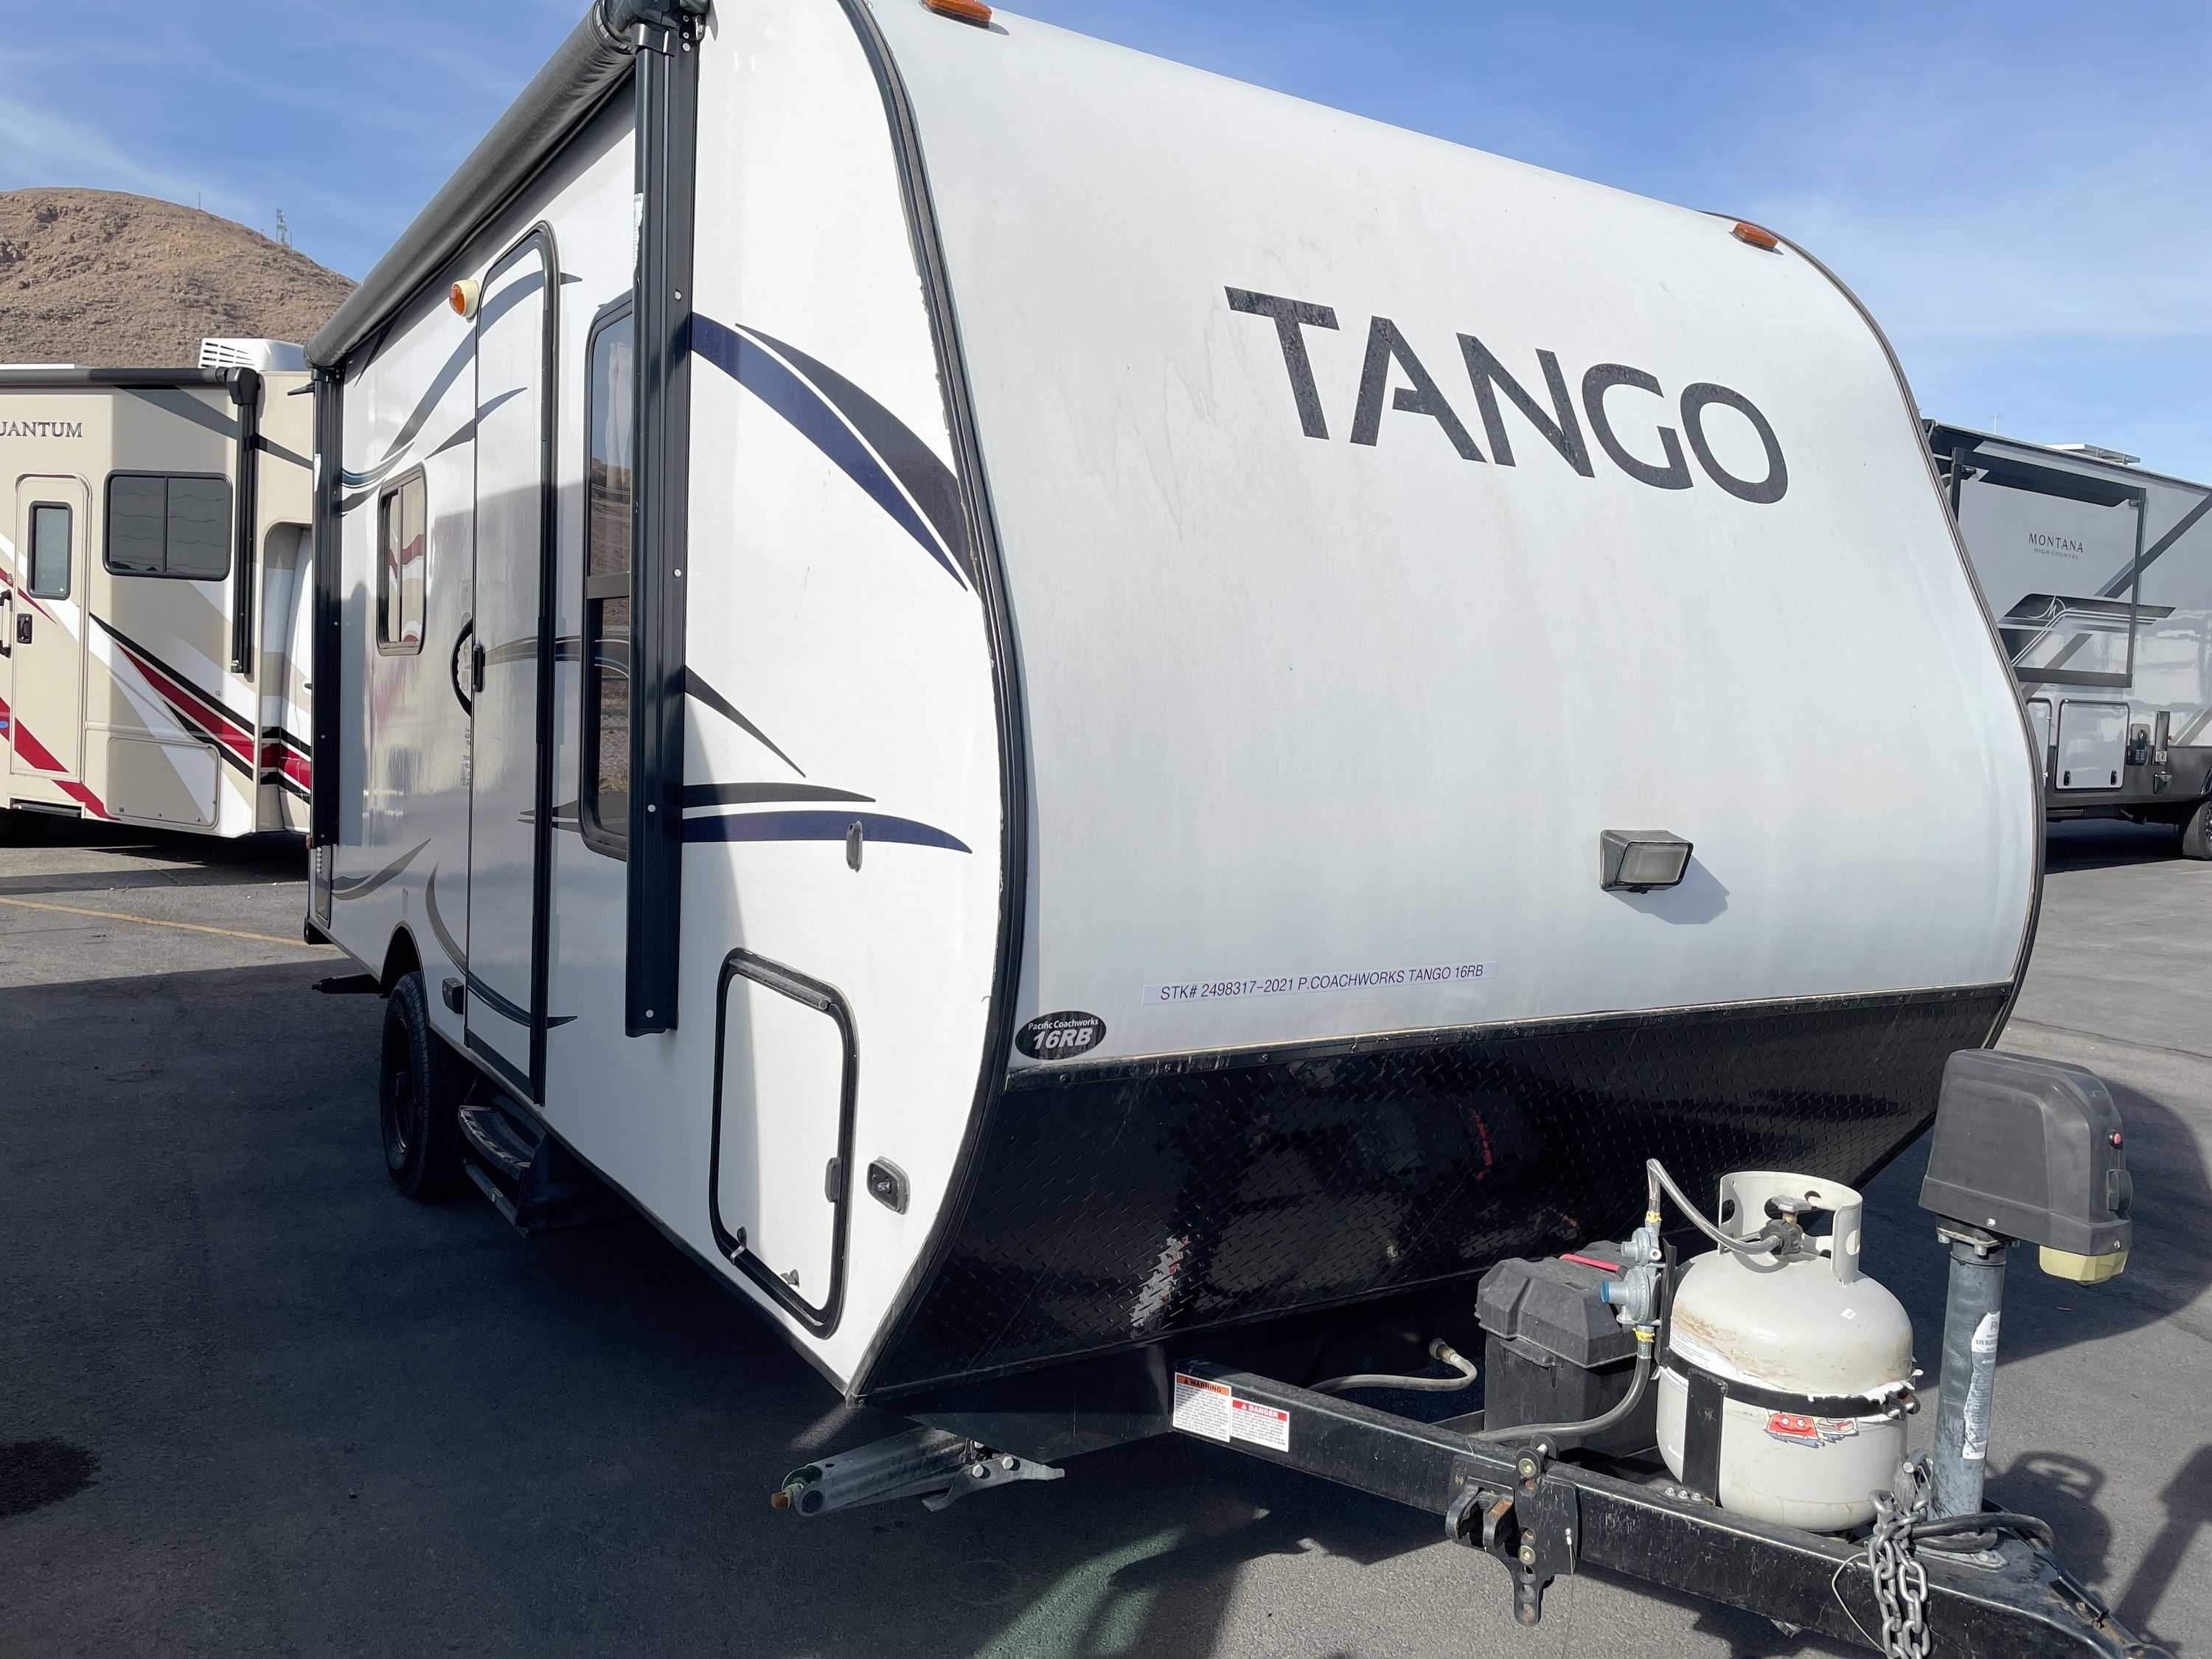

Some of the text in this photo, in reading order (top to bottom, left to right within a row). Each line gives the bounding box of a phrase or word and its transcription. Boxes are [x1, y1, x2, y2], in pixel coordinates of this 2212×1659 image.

[1224, 285, 1788, 504] TANGO
[2028, 532, 2083, 553] MONTANA
[2051, 551, 2078, 560] COUNTRY
[1161, 964, 1484, 1000] STK# 2498317-2021 P.COACHWORKS TANGO 16RB
[1028, 1018, 1099, 1031] Pacific Coachworks
[1033, 1027, 1093, 1050] 16RB
[1190, 1377, 1222, 1393] WARNING
[1248, 1405, 1279, 1419] DANGER
